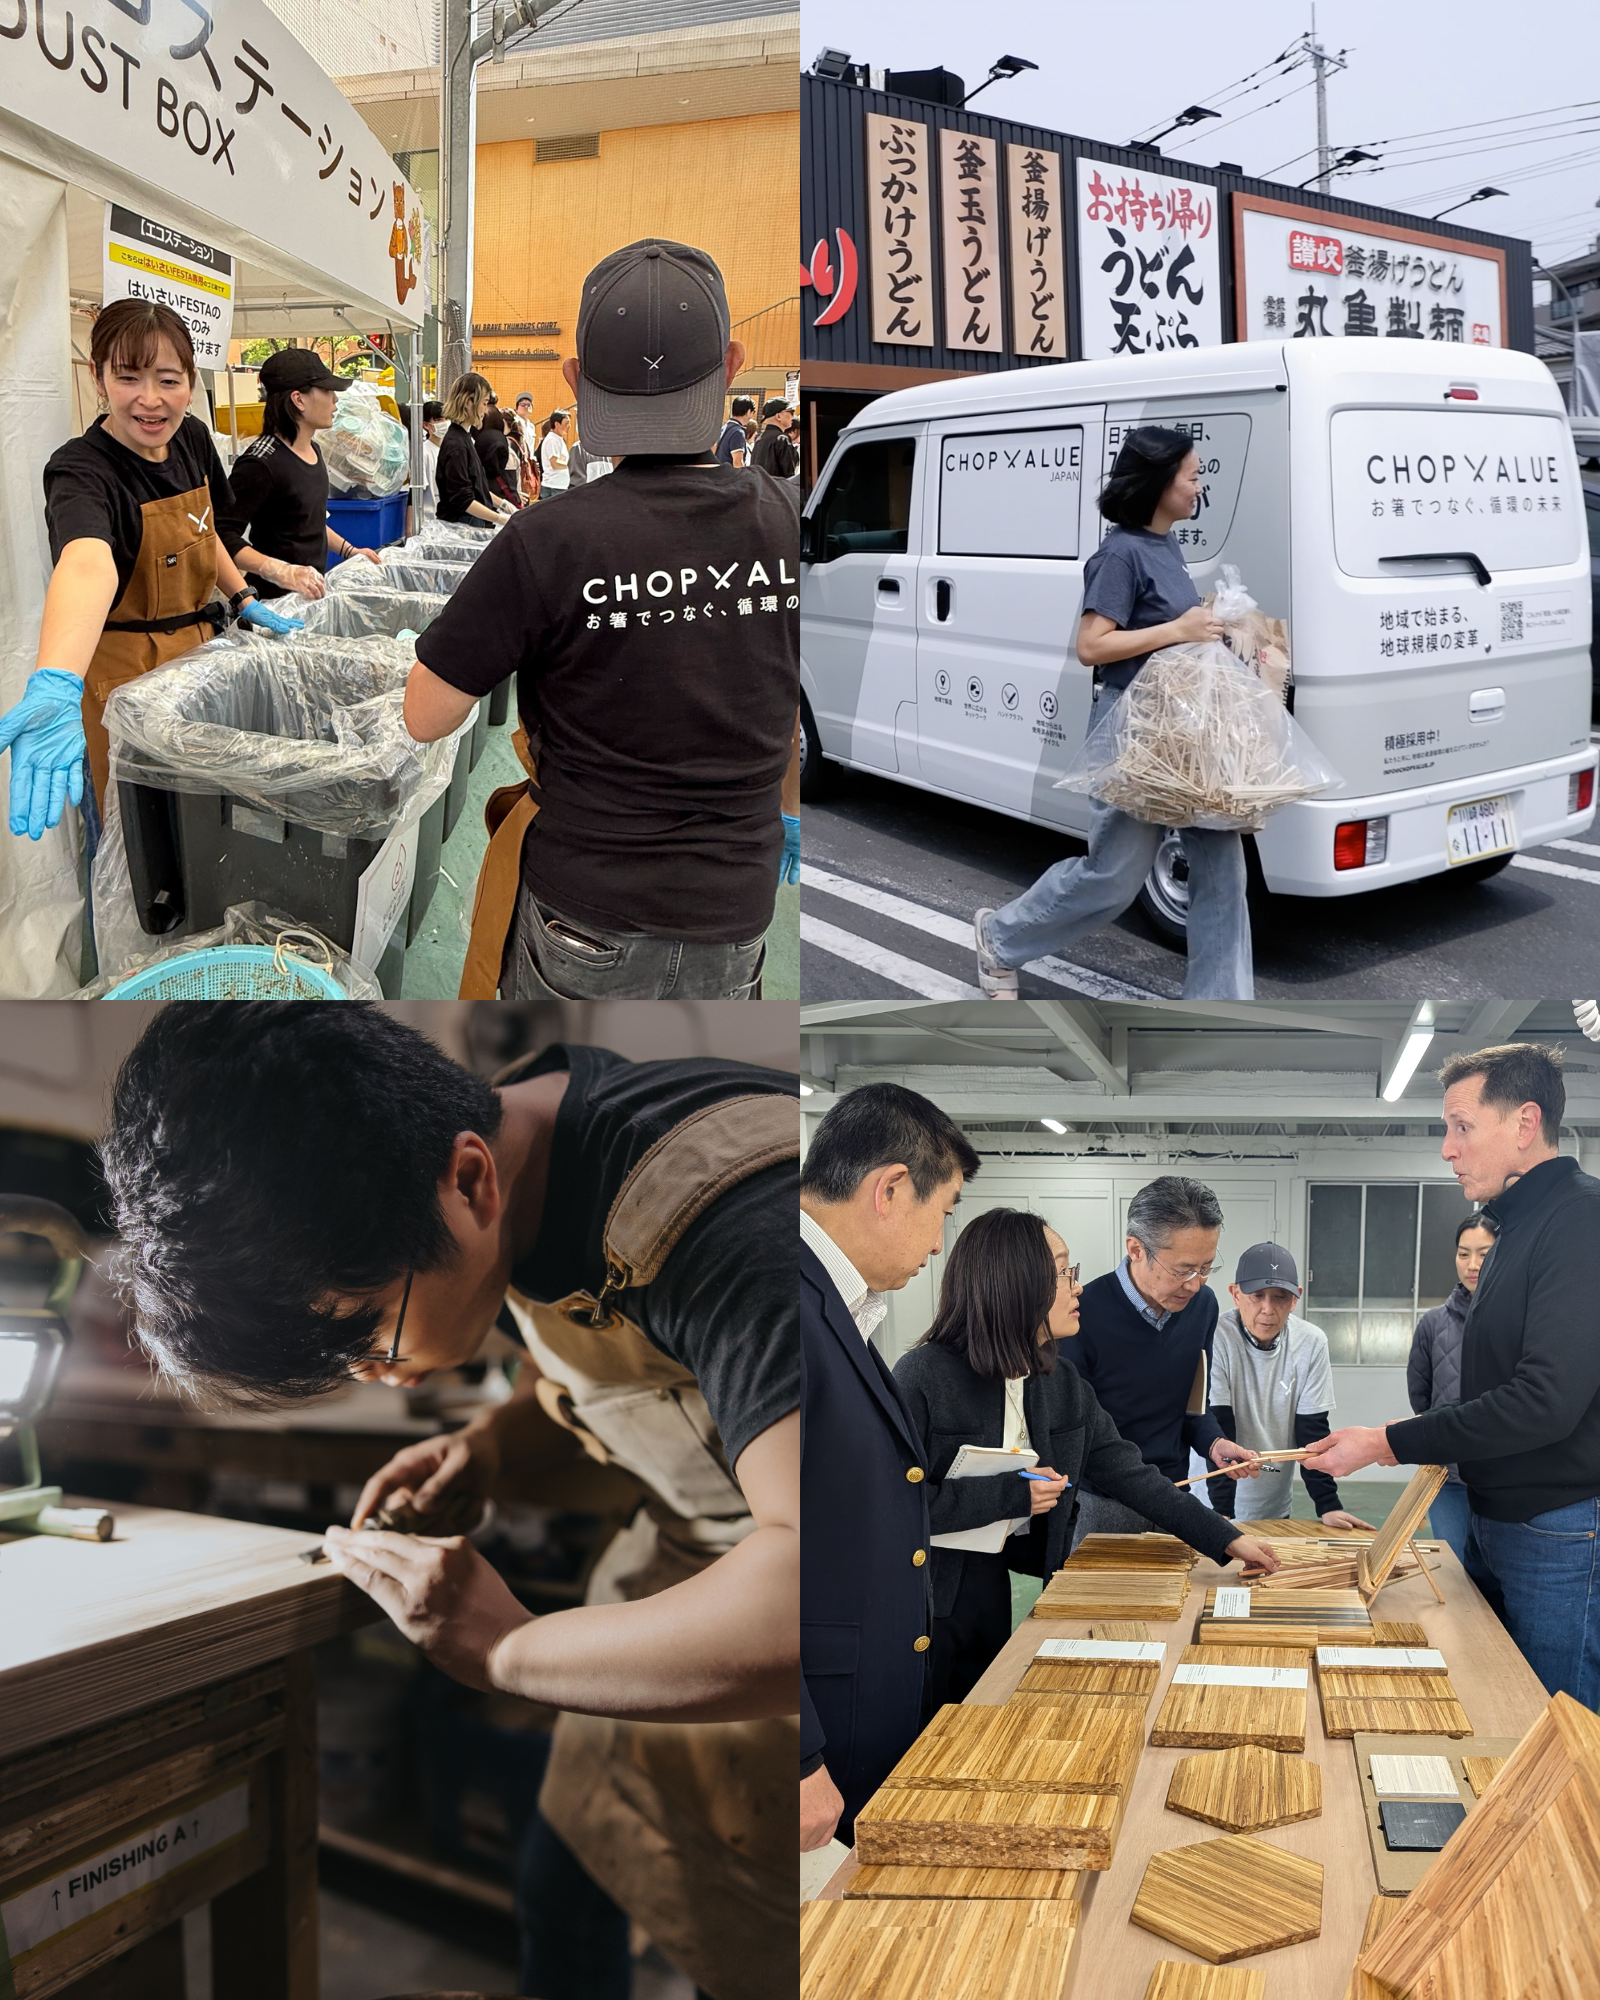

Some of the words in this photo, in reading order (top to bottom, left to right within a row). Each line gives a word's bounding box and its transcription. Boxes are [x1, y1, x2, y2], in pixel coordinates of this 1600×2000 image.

[113, 0, 385, 220] ステーション
[157, 77, 236, 176] BOX
[879, 123, 923, 338] ぶっかけうどん
[1086, 169, 1212, 241] お持ち帰り
[953, 139, 991, 345] 釜玉うどん
[1020, 151, 1055, 354] 釜揚げうどん
[1100, 225, 1204, 306] うどん
[1344, 244, 1464, 295] 釜揚げうどん
[128, 279, 221, 320] はいさいFESTAの
[800, 226, 859, 326] り
[482, 323, 502, 331] BRAVE
[536, 321, 558, 329] COURT
[1107, 297, 1200, 355] 天ぷら
[1049, 471, 1080, 483] JAPAN
[1371, 495, 1563, 518] お箸でつなぐ、循環の未来
[586, 594, 799, 630] お箸でつなぐ、循環の
[1379, 606, 1469, 631] 地域で始まる、
[1380, 629, 1479, 657] 地球規模の変革
[1479, 801, 1495, 818] 480
[68, 1833, 169, 1899] FINISHING
[173, 1825, 188, 1846] A
